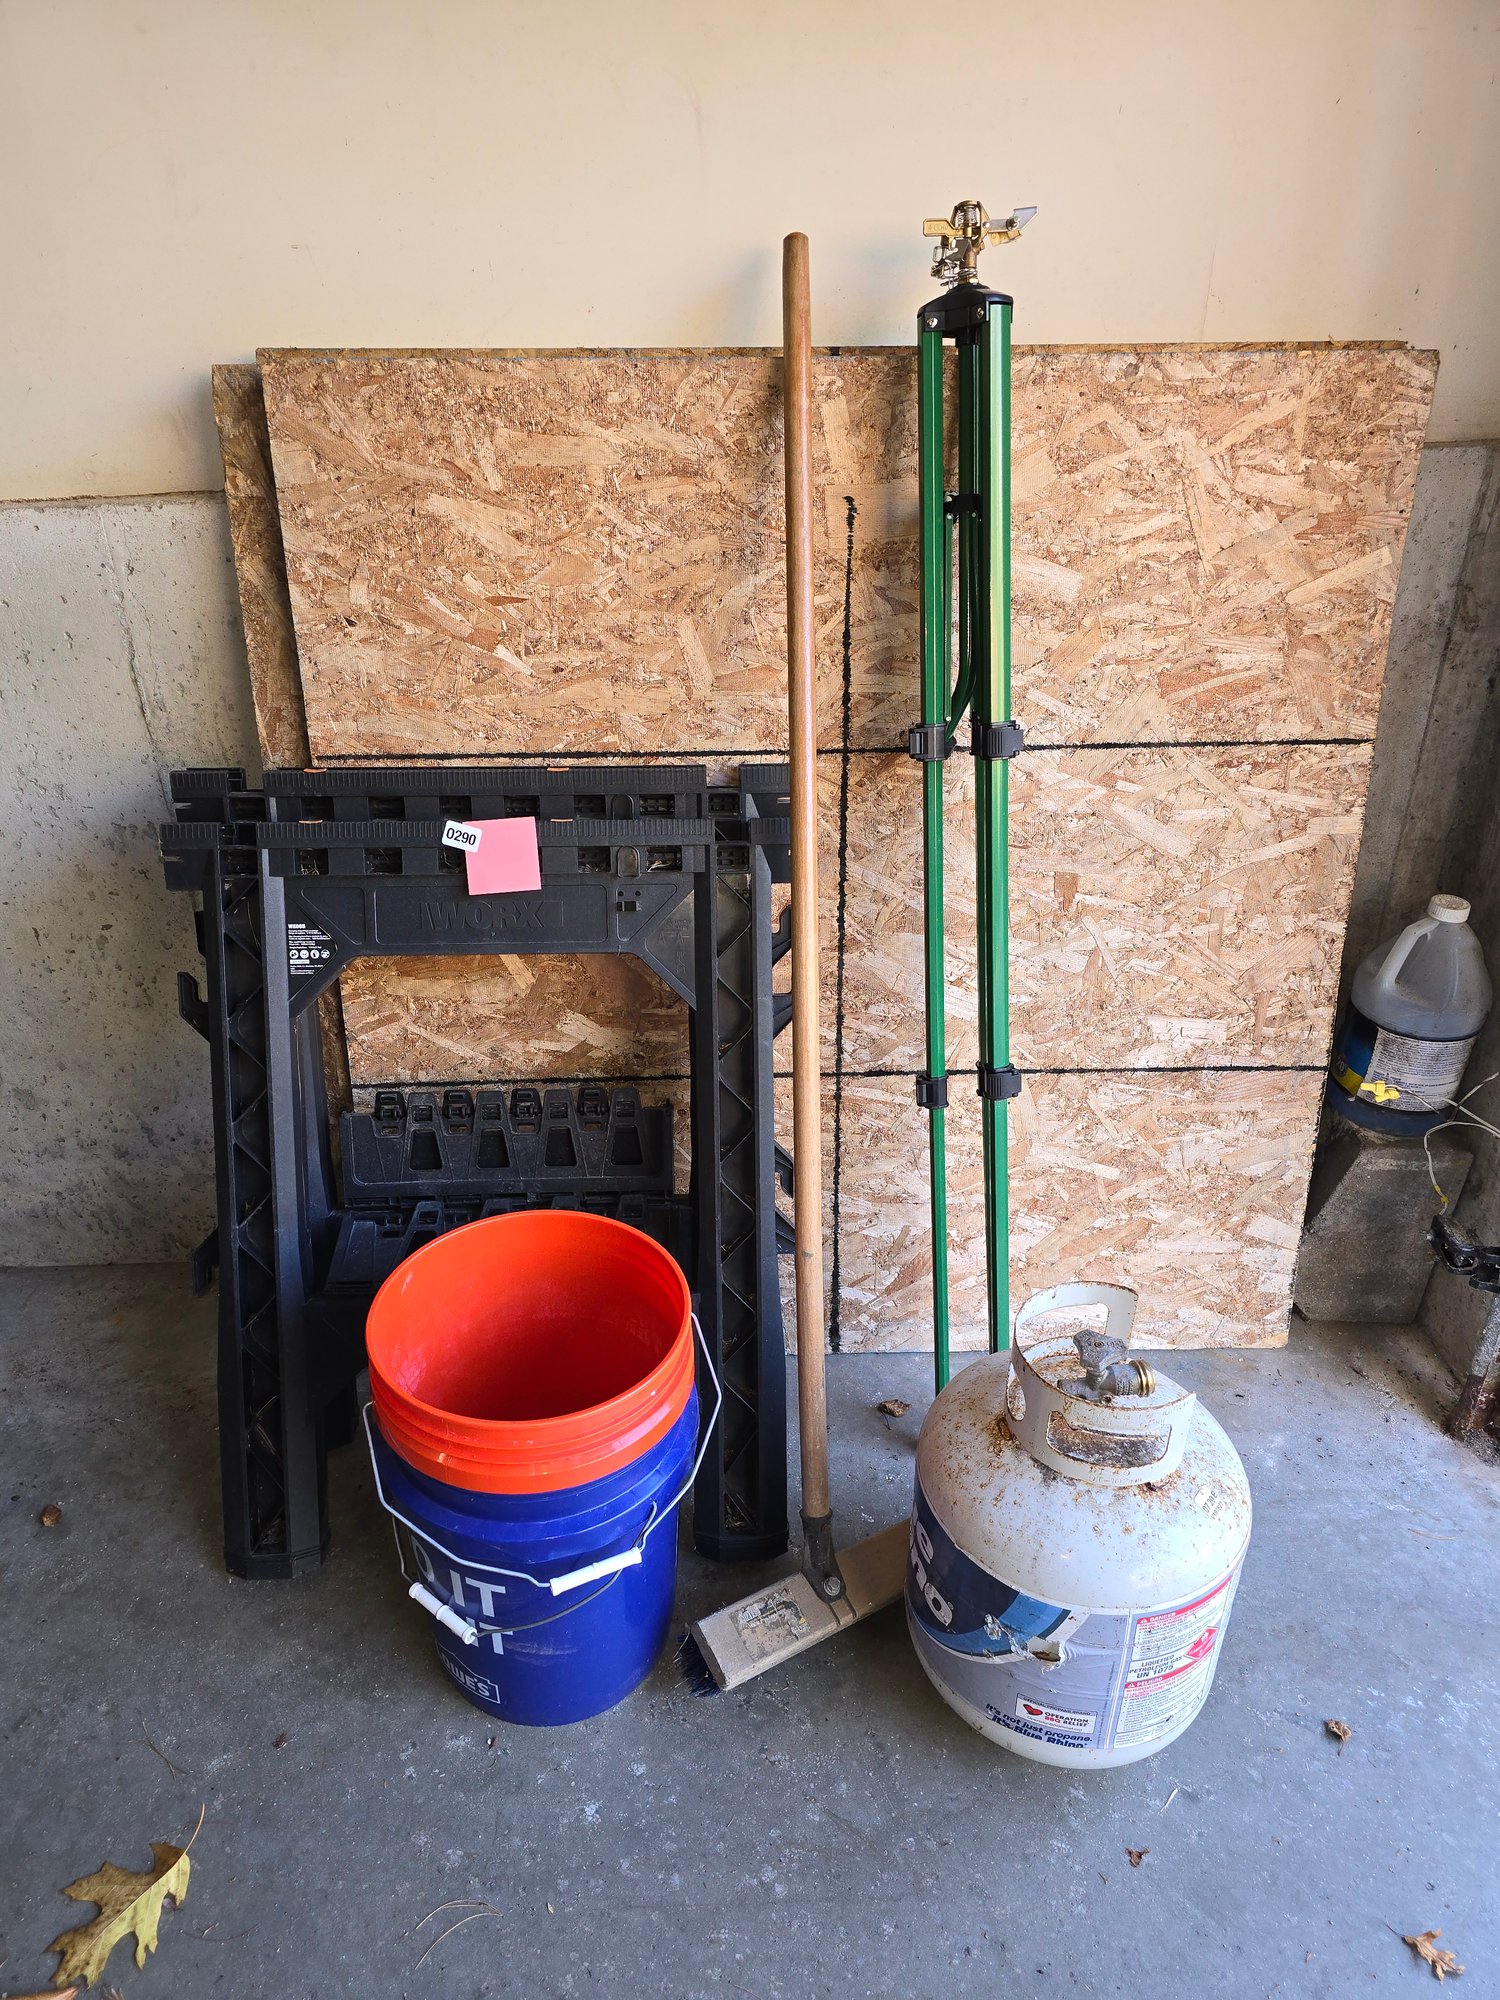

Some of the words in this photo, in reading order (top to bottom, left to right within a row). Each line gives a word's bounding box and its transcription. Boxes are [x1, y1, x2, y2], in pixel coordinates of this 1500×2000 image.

[445, 827, 477, 846] 0290
[449, 1569, 506, 1618] IT
[441, 1652, 490, 1697] OWE'S
[1136, 1671, 1150, 1679] UN
[1044, 1711, 1089, 1723] OPERATION
[1062, 1720, 1089, 1728] RELIEF
[1003, 1714, 1021, 1726] not
[1022, 1721, 1044, 1734] just
[1044, 1729, 1093, 1743] propane.
[1013, 1726, 1043, 1741] Blue
